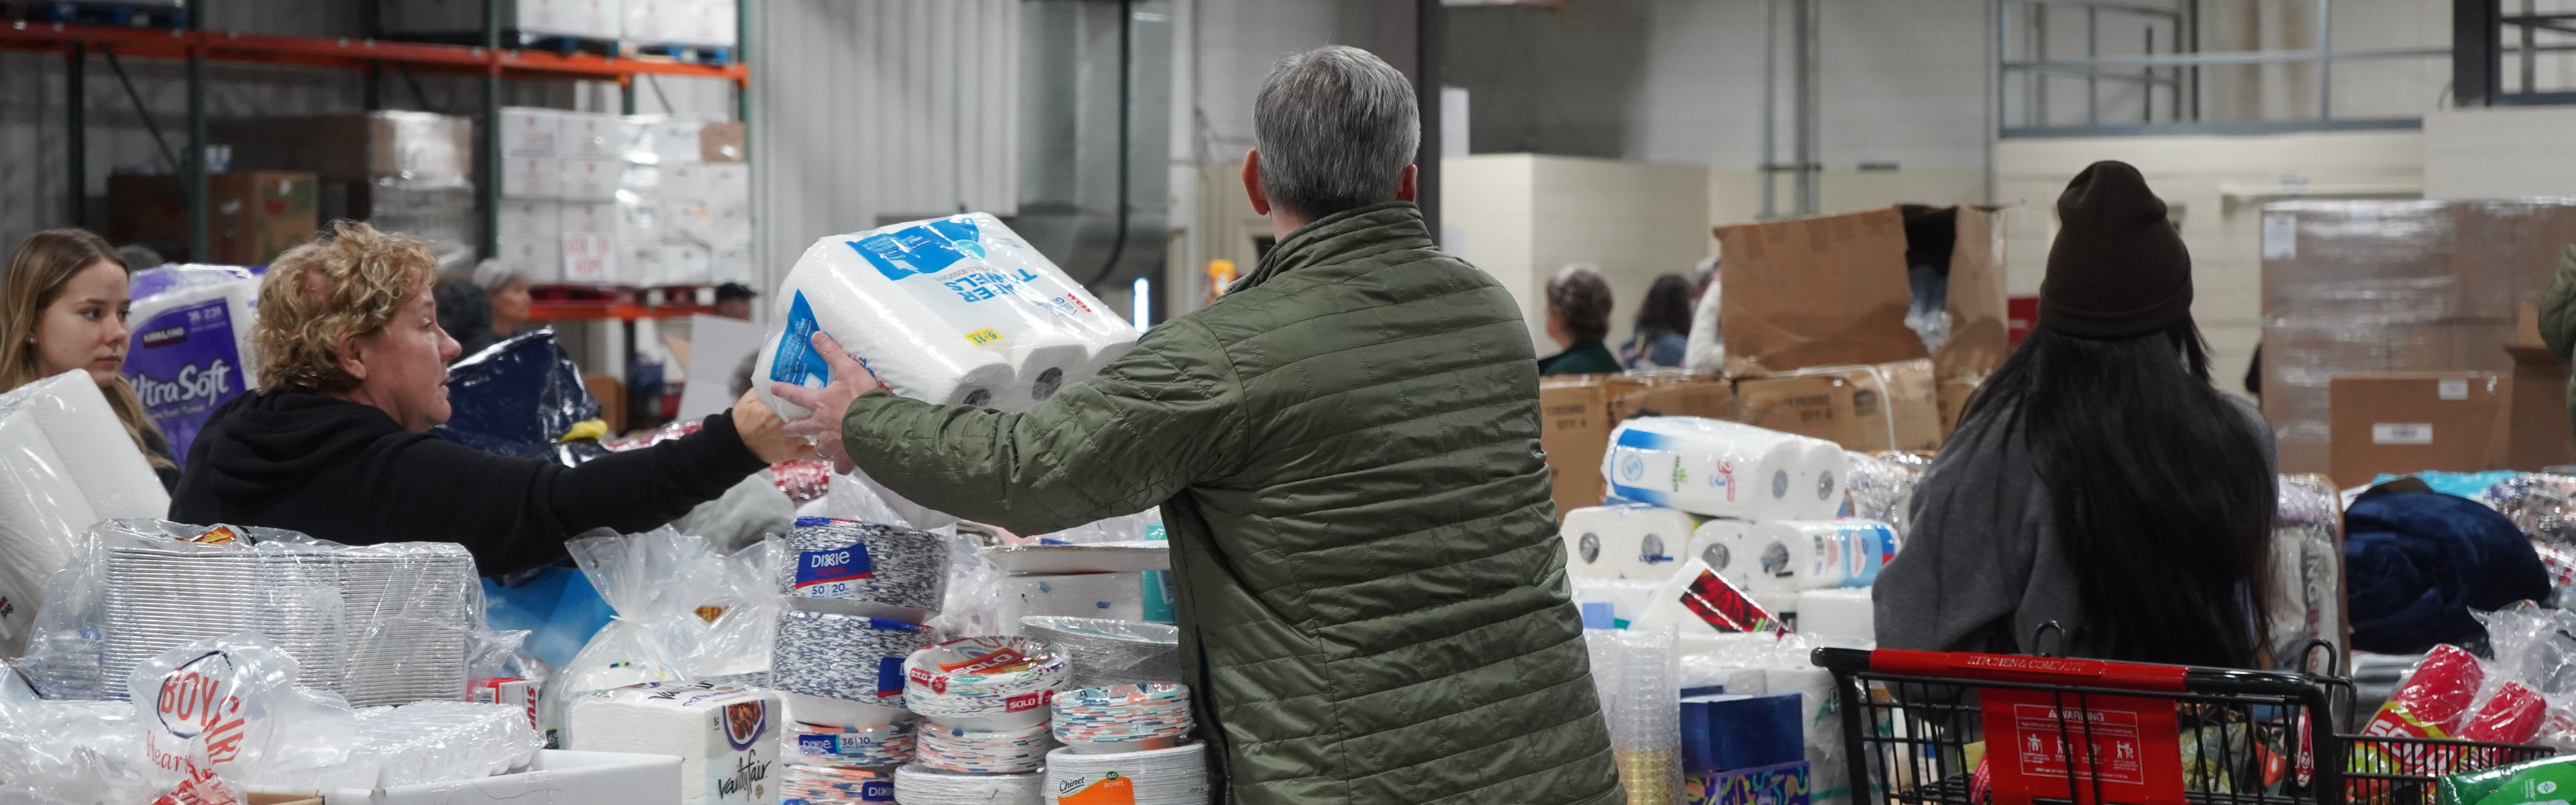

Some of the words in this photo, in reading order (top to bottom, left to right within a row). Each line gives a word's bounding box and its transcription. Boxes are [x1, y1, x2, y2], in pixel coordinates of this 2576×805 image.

[178, 358, 231, 407] Soft
[811, 551, 850, 568] DIXIE
[812, 586, 824, 594] 50
[832, 583, 845, 593] 20
[951, 653, 1014, 674] SOLO
[1967, 656, 2017, 667] KITCHEN
[2018, 659, 2026, 667] &
[2028, 660, 2086, 672] COMPANY
[910, 669, 927, 681] SOLO
[160, 667, 219, 727] BOY
[1009, 698, 1036, 710] SOLO
[714, 716, 720, 726] 84
[2060, 710, 2104, 721] WARING
[859, 737, 870, 745] 10
[2365, 718, 2455, 771] SOLO
[1059, 776, 1085, 792] Chinet
